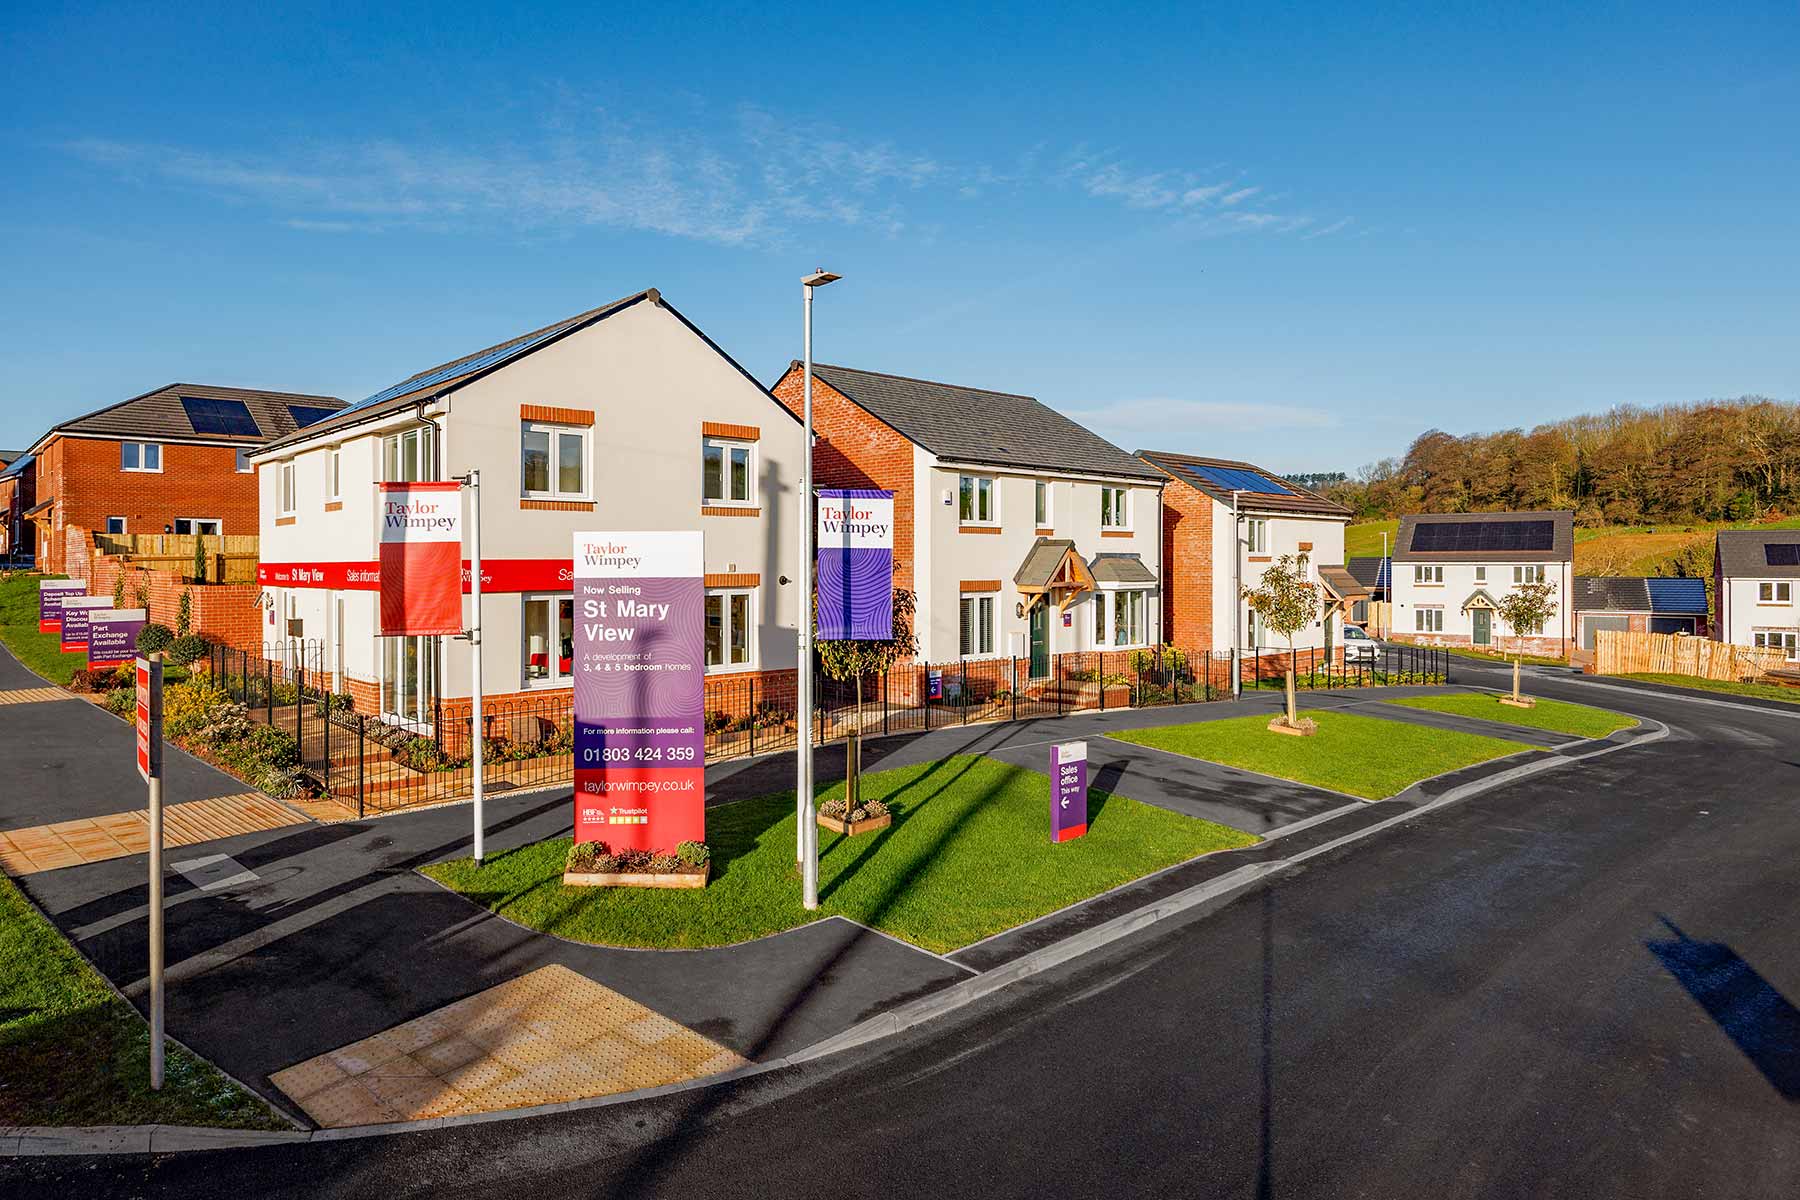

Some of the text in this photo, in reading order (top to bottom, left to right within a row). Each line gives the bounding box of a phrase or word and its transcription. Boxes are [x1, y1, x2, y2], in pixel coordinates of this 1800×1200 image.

[384, 499, 439, 516] Taylor
[822, 505, 872, 523] Taylor
[386, 514, 456, 531] Wimpey
[823, 520, 888, 537] Wimpey
[584, 542, 627, 555] Taylor
[584, 555, 641, 568] Wimpey
[292, 568, 298, 581] St
[299, 568, 311, 584] Mary
[312, 568, 324, 582] View
[347, 569, 380, 583] Sales informat
[584, 585, 641, 595] Now Selling
[584, 600, 669, 620] St Mary
[584, 623, 634, 641] View
[584, 652, 652, 663] A development of
[584, 662, 691, 672] 3, 4 & 5 bedroom homes
[616, 727, 655, 735] information
[656, 727, 679, 736] please
[680, 726, 695, 734] call:
[584, 747, 695, 761] 01803 424 359
[1061, 765, 1078, 776] Sales
[584, 780, 695, 794] taylorwimpey.co.uk
[1061, 775, 1079, 785] office
